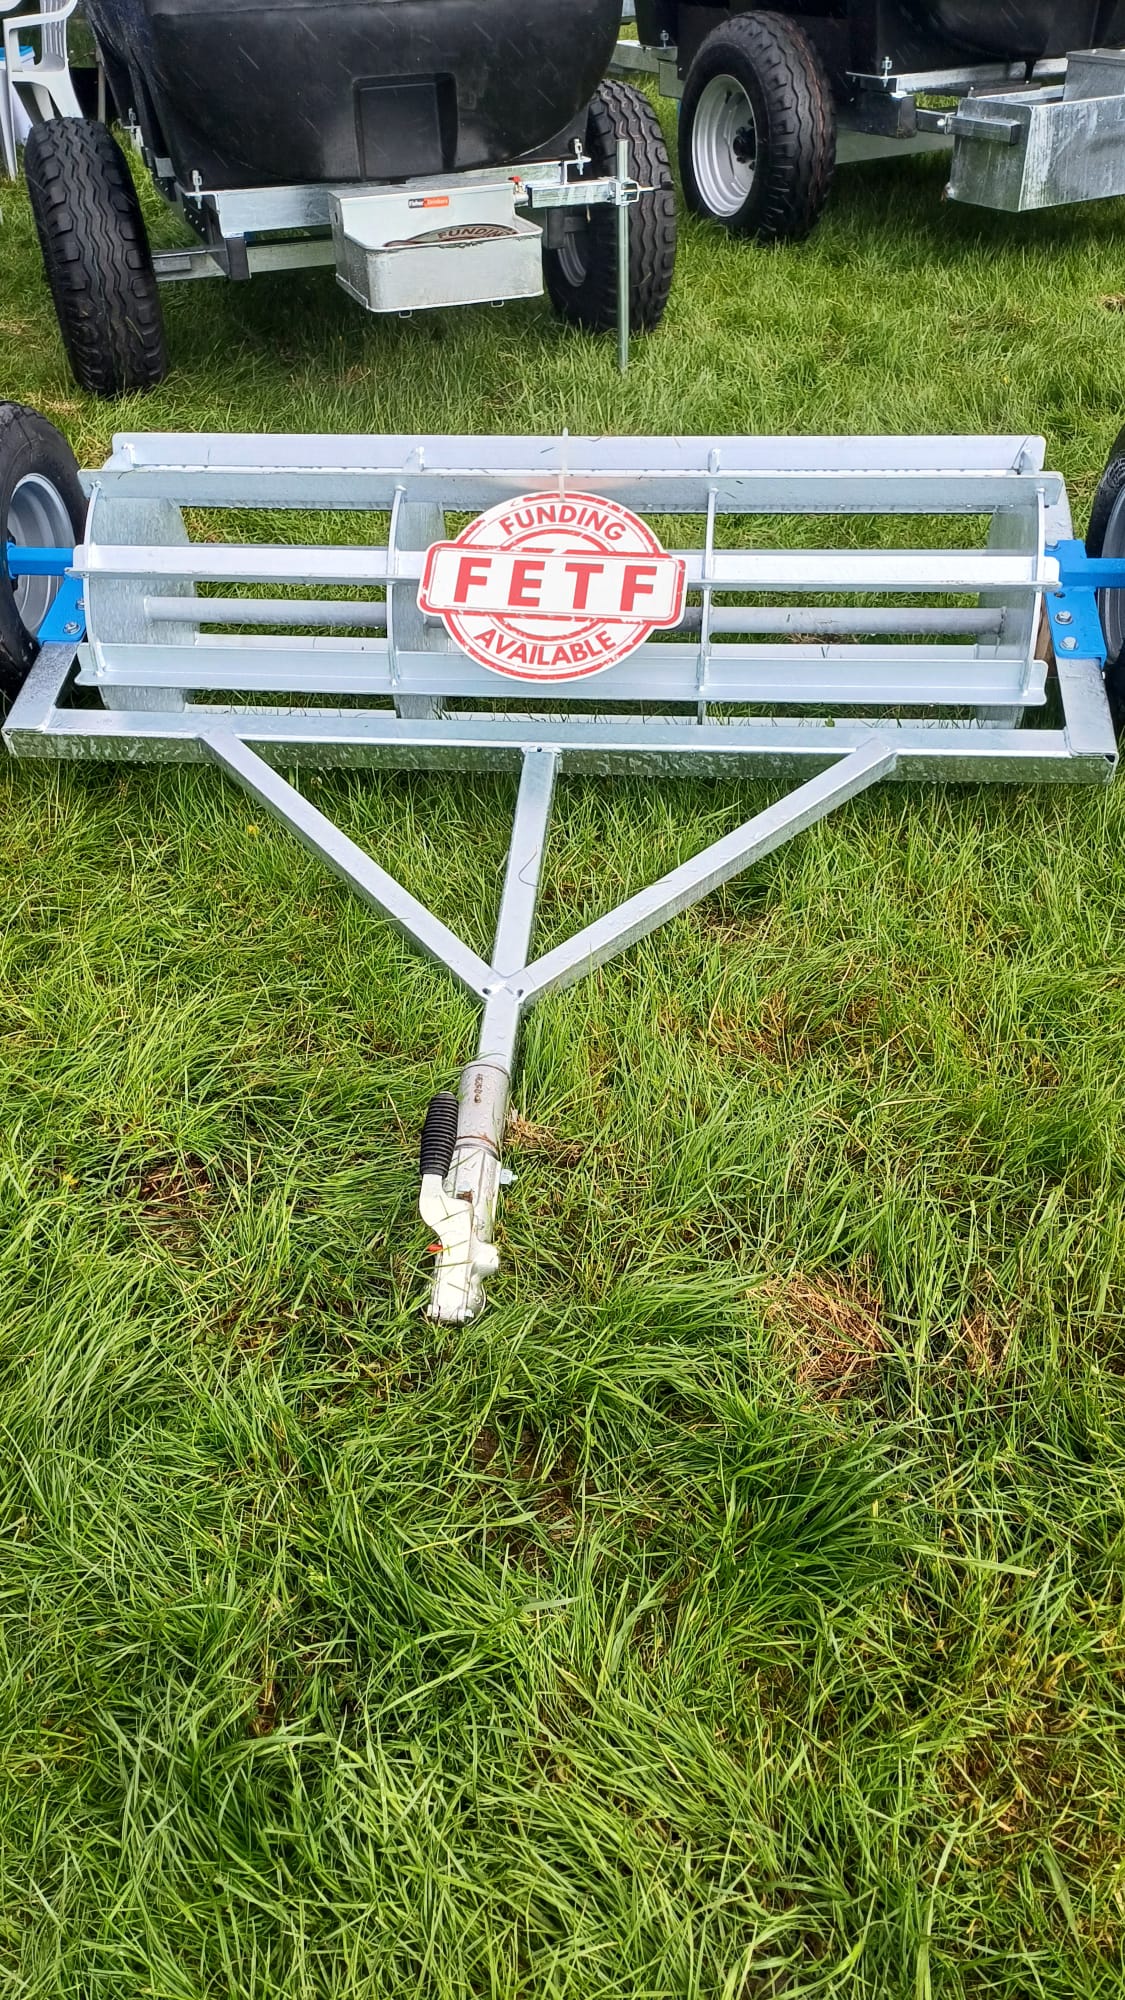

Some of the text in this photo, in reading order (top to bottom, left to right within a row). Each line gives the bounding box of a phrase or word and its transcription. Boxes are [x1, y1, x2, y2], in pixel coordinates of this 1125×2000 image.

[437, 228, 504, 239] FUNDIN
[498, 505, 626, 541] FUNDING
[453, 557, 657, 611] FETF
[473, 628, 616, 666] AVAILABLE
